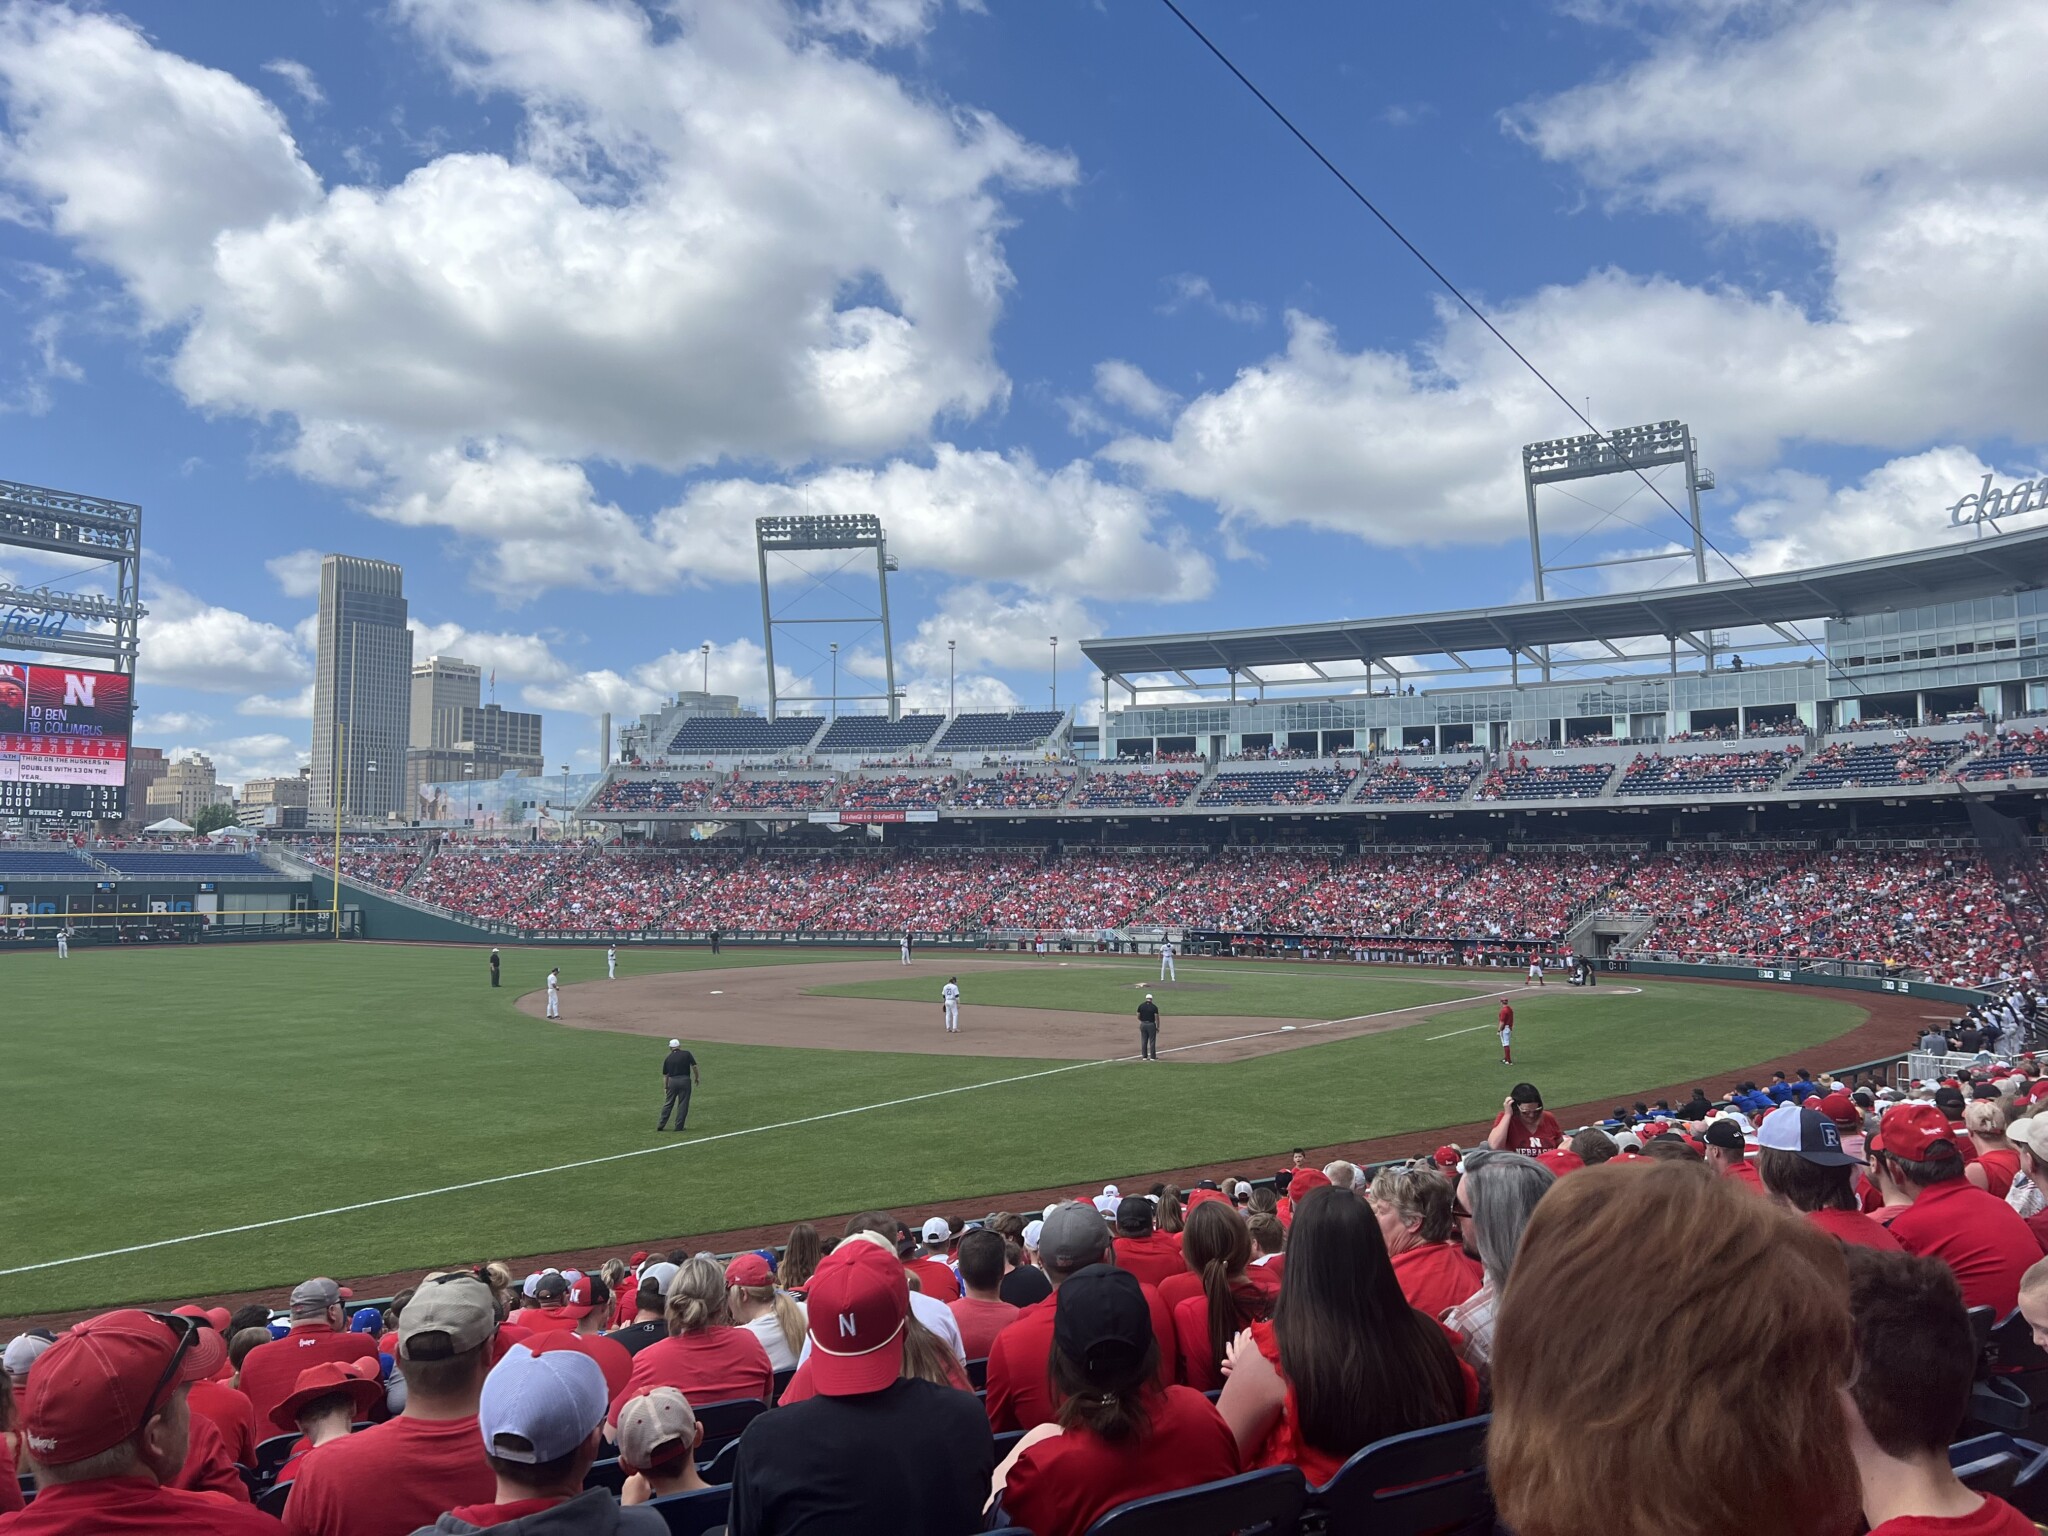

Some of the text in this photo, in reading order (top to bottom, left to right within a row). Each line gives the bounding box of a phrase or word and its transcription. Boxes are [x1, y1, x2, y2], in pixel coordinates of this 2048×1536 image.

[0, 606, 69, 639] field
[6, 634, 57, 648] OMAHA
[63, 674, 96, 707] N
[30, 706, 67, 721] 10 BEN
[45, 722, 103, 736] COLUMBUS
[15, 741, 25, 751] 34
[49, 744, 57, 754] 31
[82, 746, 88, 755] 4
[98, 747, 104, 756] 0
[114, 748, 119, 757] 7
[21, 764, 52, 772] DOUBLES
[70, 758, 101, 766] HUSKERS
[6, 787, 12, 796] 0
[16, 787, 22, 797] 0
[25, 787, 31, 797] 0
[102, 791, 108, 800] 3
[5, 797, 12, 807] 0
[15, 797, 22, 807] 0
[25, 797, 31, 807] 0
[102, 801, 108, 809] 4
[57, 809, 64, 818] 2
[86, 810, 93, 818] 0
[318, 912, 330, 920] 335
[1608, 961, 1628, 970] 0:11
[1529, 1136, 1542, 1148] N
[1825, 1129, 1839, 1146] R
[1516, 1147, 1552, 1156] NEBRAS
[570, 1288, 581, 1304] N
[838, 1313, 857, 1337] N
